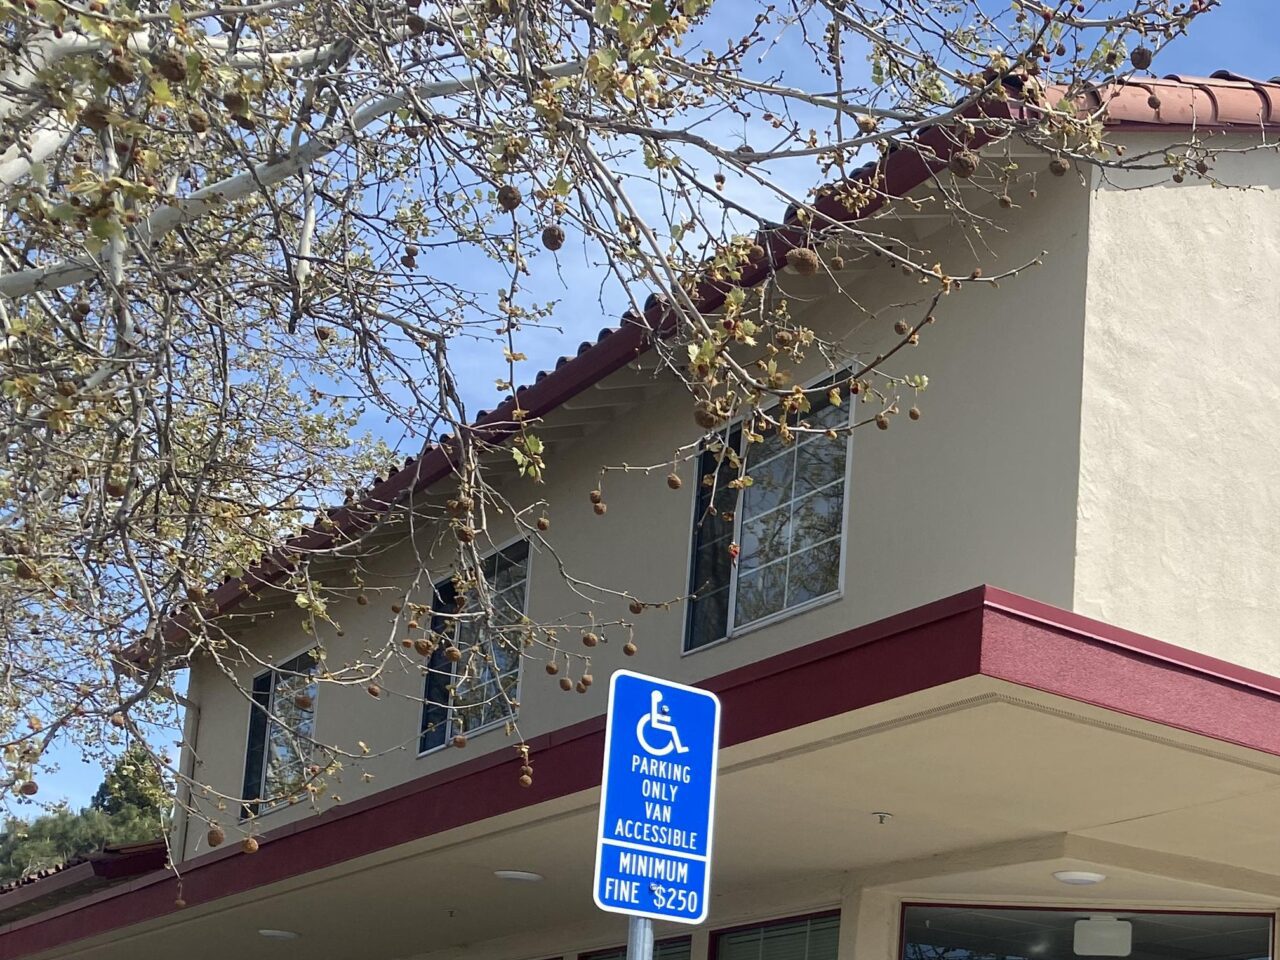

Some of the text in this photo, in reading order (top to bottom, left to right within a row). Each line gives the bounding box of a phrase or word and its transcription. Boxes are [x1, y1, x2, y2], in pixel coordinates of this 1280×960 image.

[632, 755, 691, 783] PARKING
[641, 779, 678, 802] ONLY
[644, 801, 671, 823] VAN
[615, 818, 697, 850] ACCESSIBLE
[619, 851, 688, 884] MINIMUM
[605, 878, 698, 913] FINE $250
